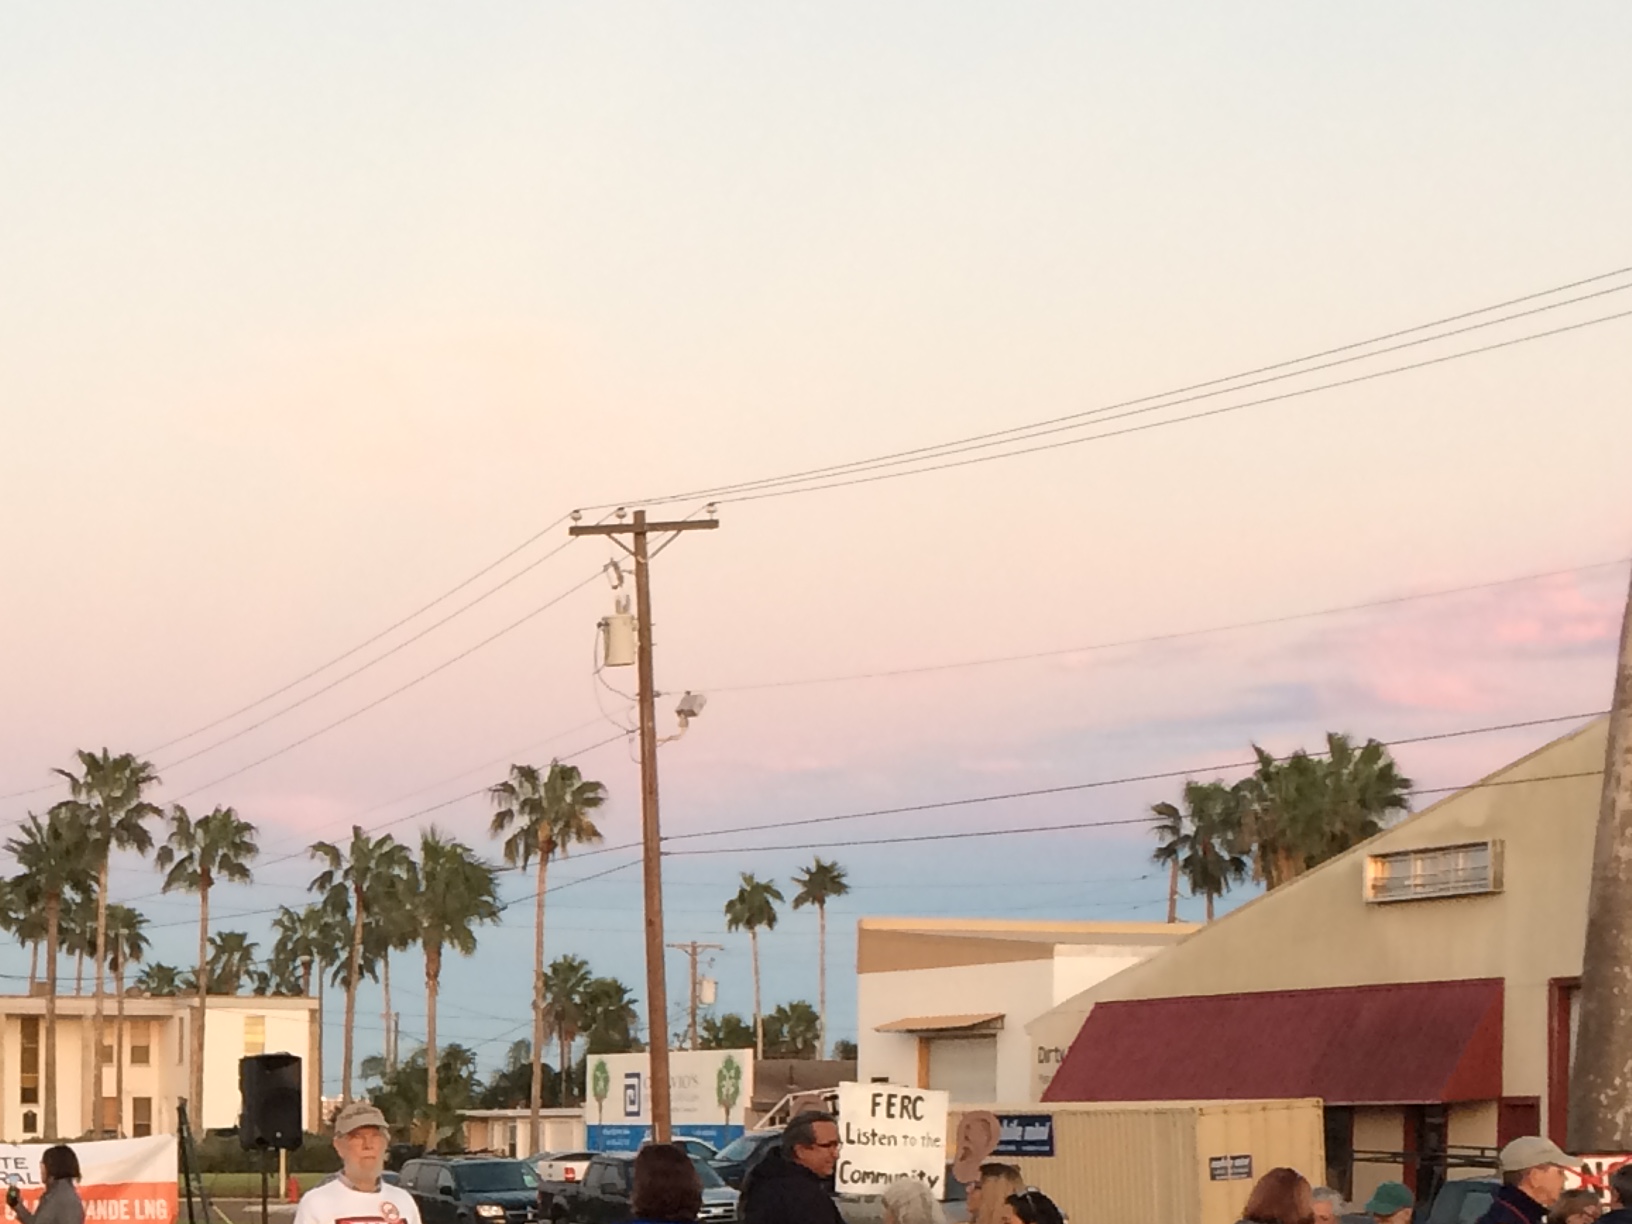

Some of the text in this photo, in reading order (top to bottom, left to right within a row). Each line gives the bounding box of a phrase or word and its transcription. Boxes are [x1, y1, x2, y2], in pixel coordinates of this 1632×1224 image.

[871, 1093, 925, 1121] FERC
[845, 1121, 898, 1146] Listen
[134, 1199, 167, 1220] LNG
